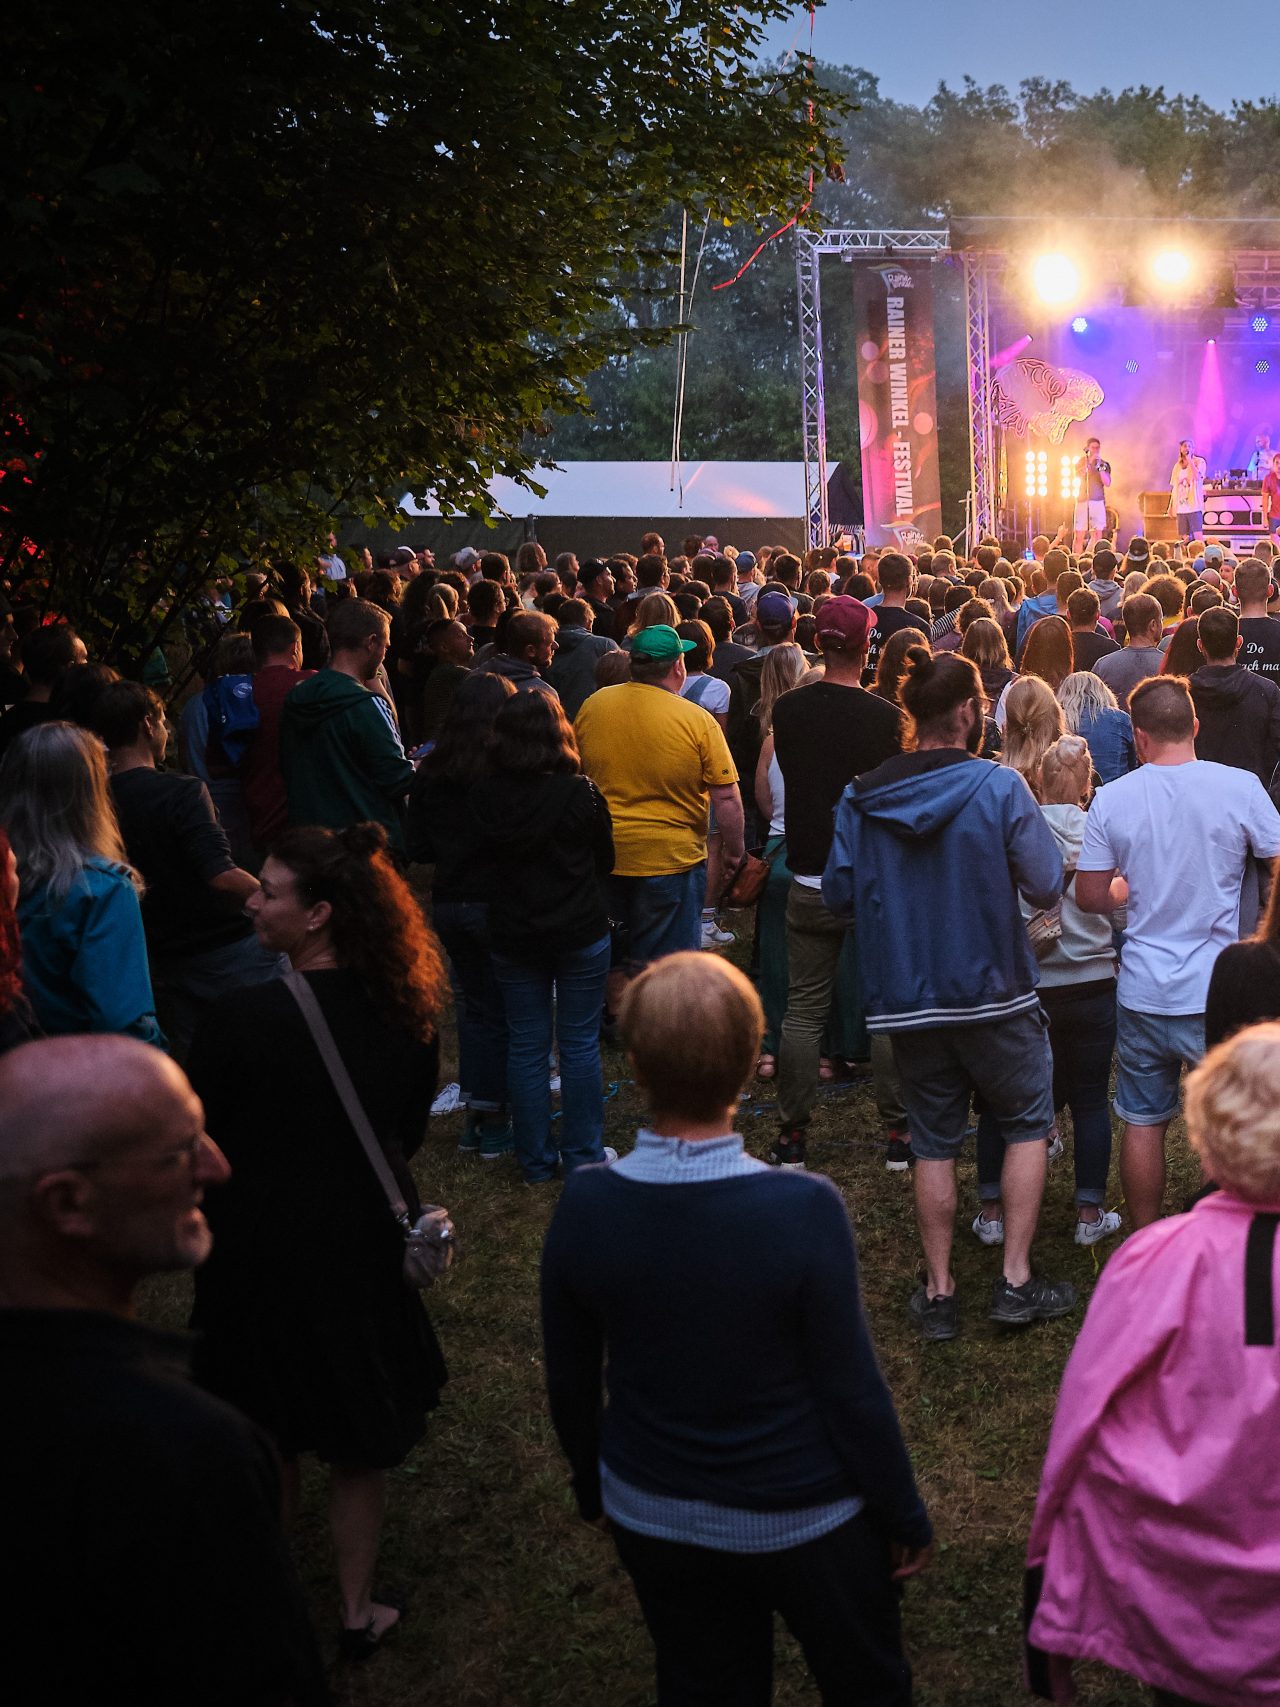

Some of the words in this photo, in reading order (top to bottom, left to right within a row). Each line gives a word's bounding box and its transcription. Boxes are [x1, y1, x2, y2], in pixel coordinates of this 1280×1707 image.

[887, 297, 906, 359] RAINER
[890, 363, 909, 428] WINKEL
[893, 442, 913, 517] FESTIVAL
[869, 628, 882, 640] Do
[1246, 642, 1264, 654] Do
[1262, 663, 1280, 671] ma
